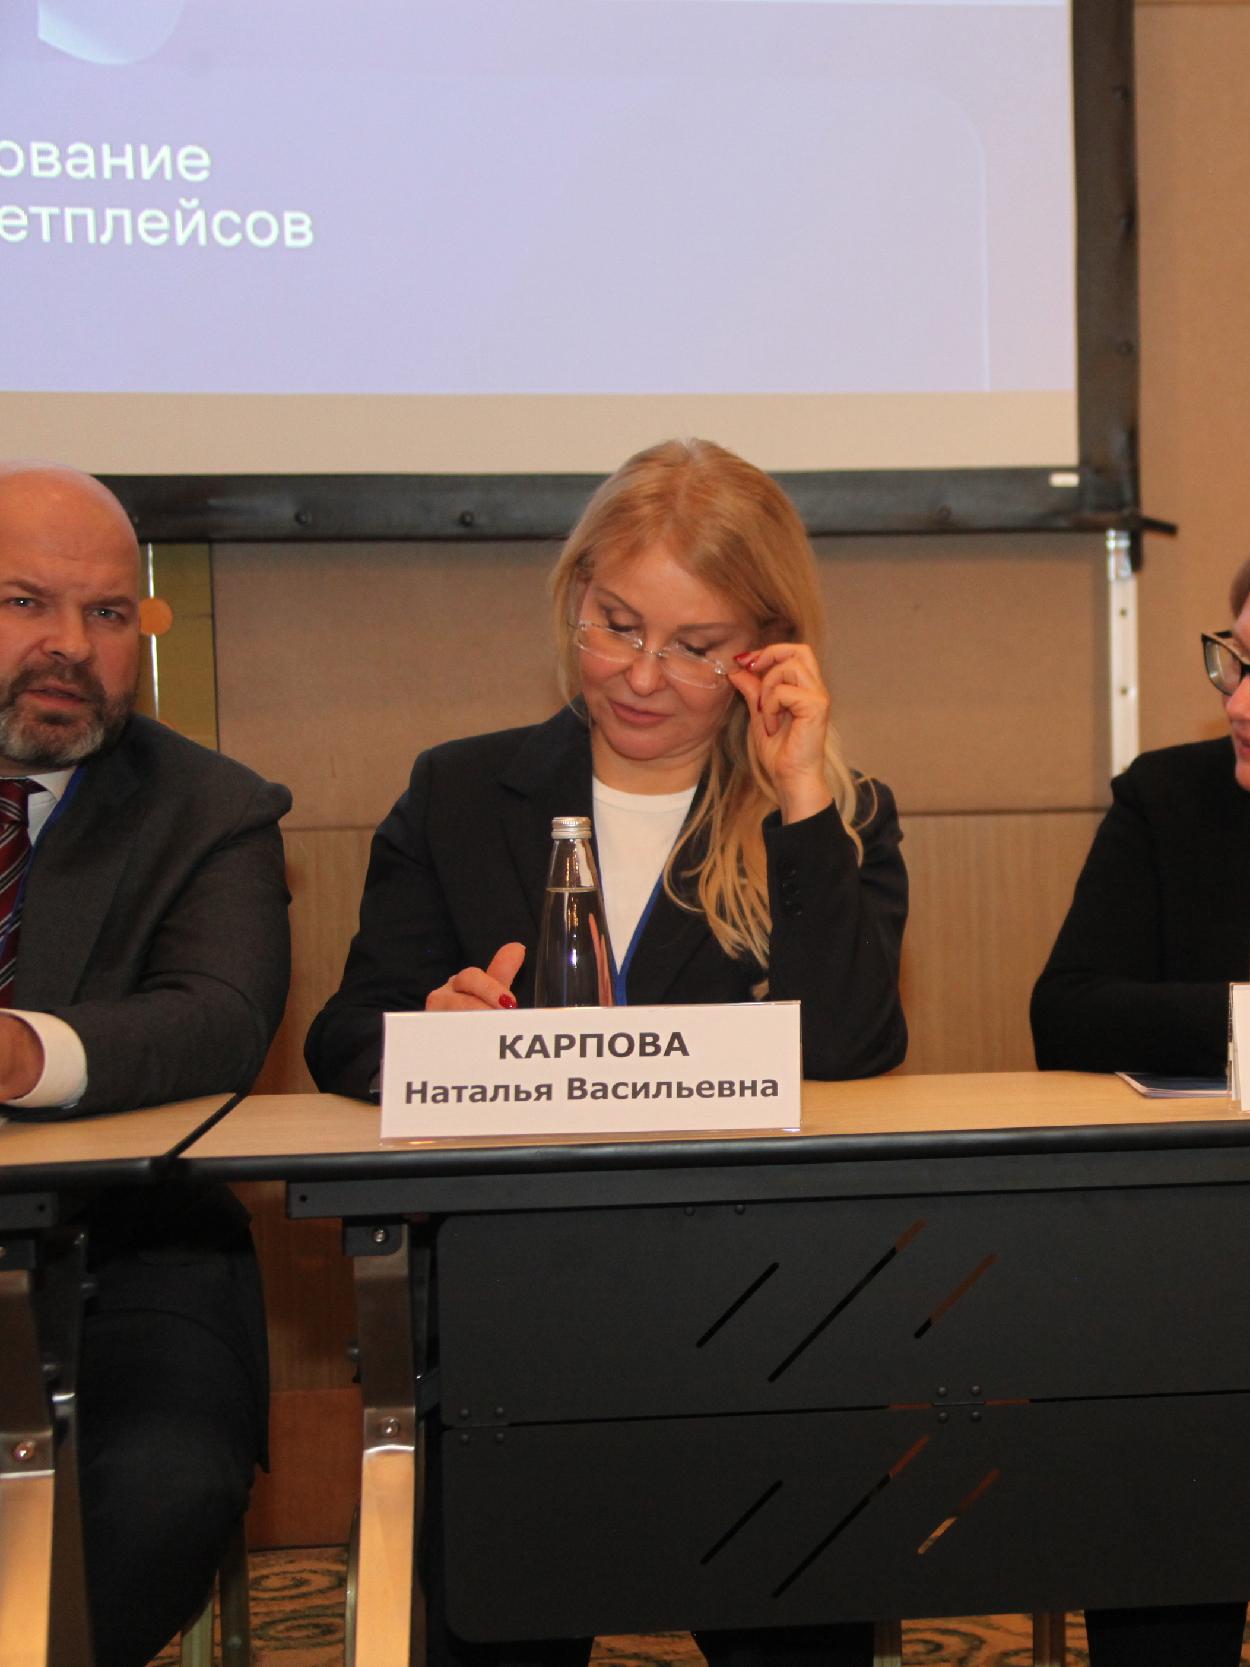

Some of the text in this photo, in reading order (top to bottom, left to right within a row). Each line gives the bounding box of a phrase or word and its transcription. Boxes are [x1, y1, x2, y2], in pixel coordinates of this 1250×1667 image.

[0, 140, 211, 182] ование
[0, 197, 314, 248] етплейсов
[499, 1031, 690, 1060] КАРПОВА
[405, 1077, 779, 1105] Наталья Васильевна
